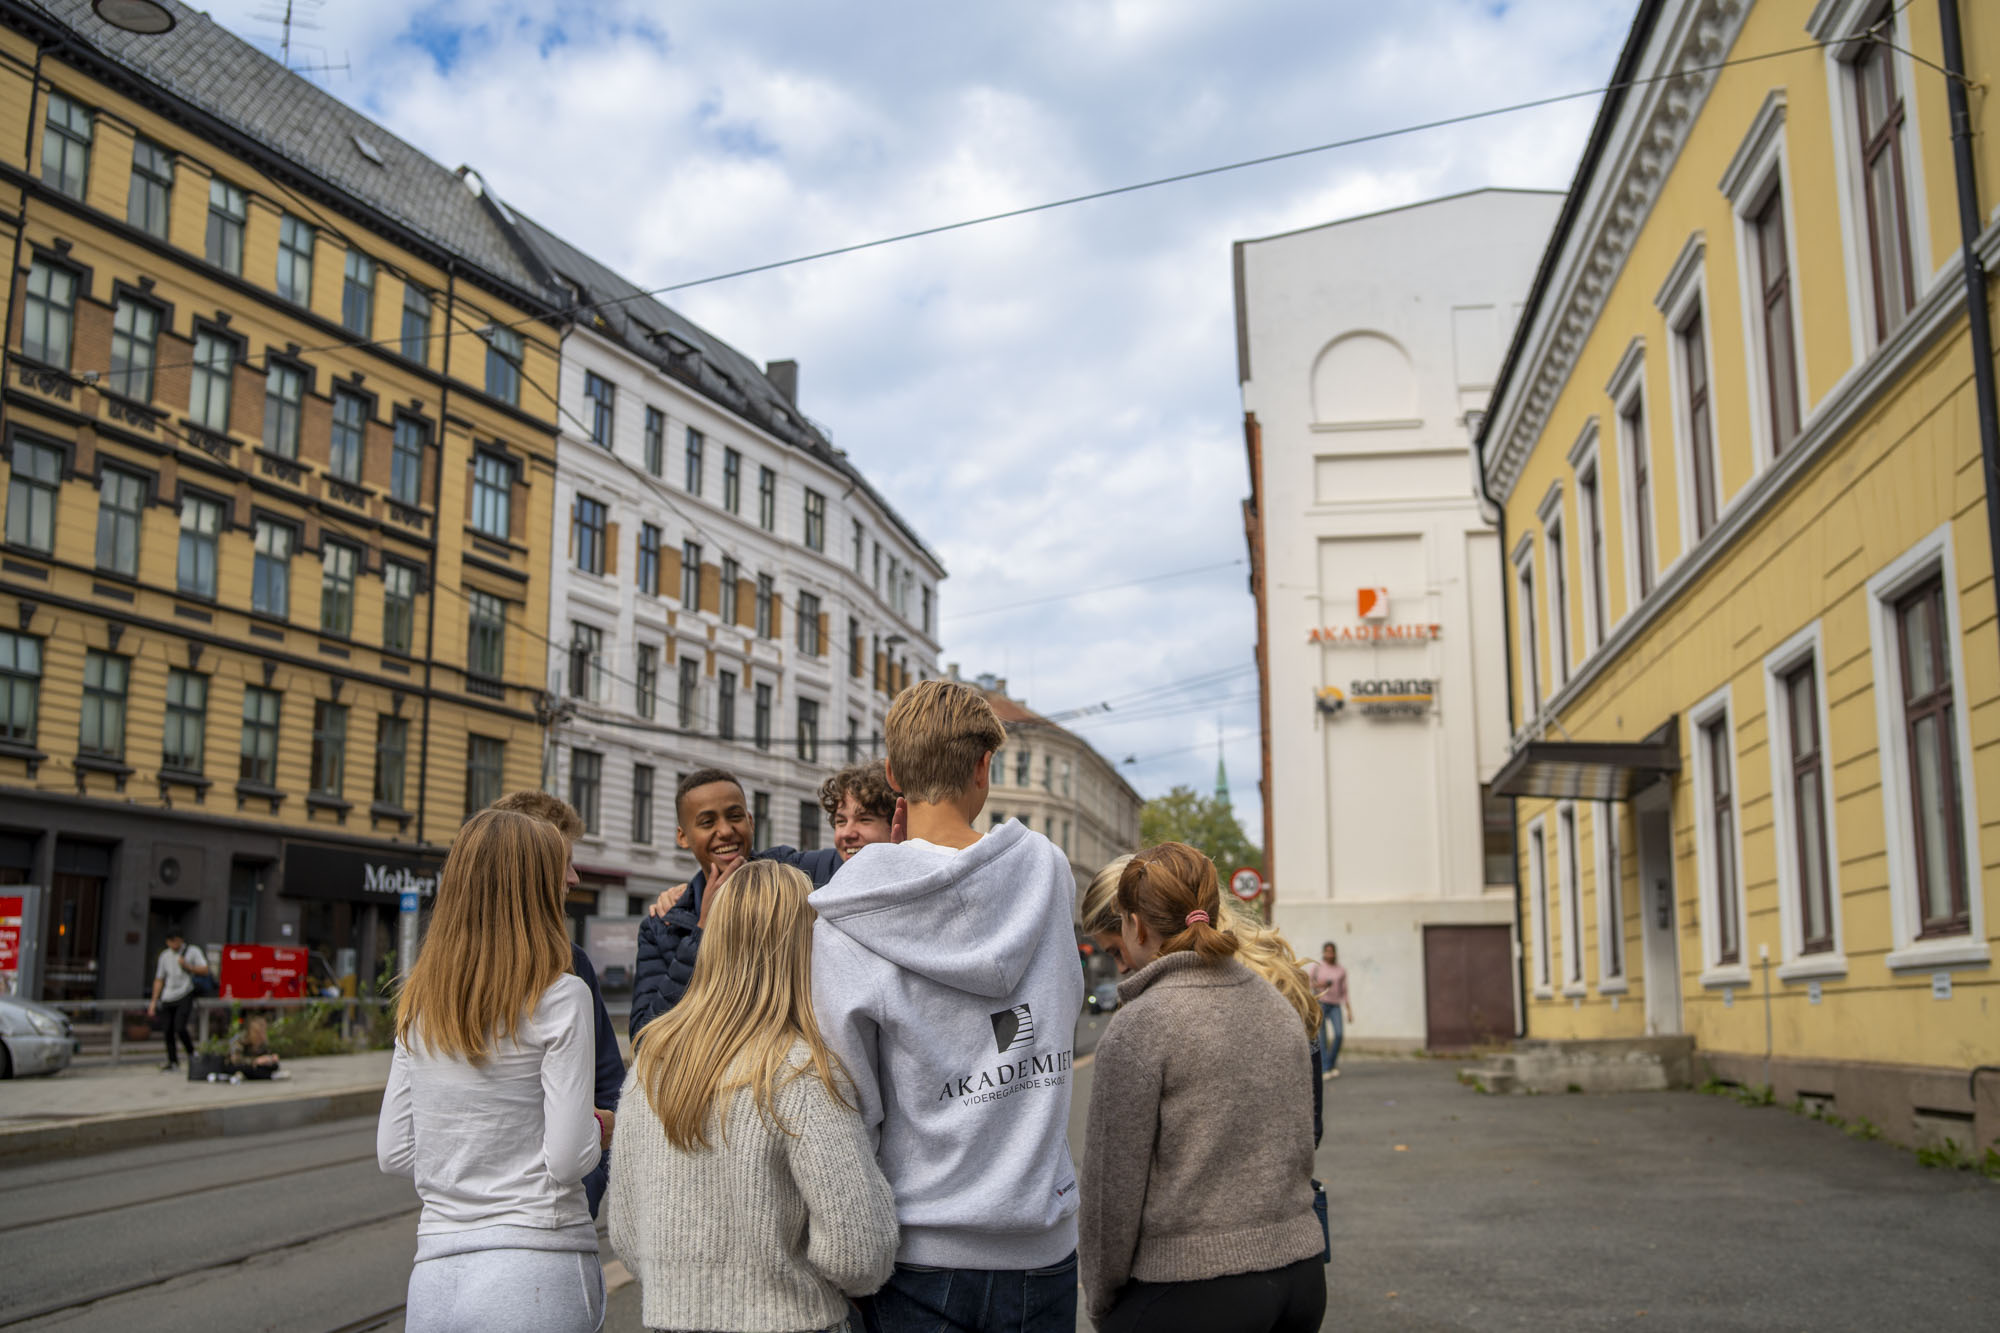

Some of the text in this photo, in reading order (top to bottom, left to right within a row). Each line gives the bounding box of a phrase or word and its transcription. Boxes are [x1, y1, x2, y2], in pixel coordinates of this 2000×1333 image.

[1308, 624, 1441, 644] AKADEMIET
[1350, 678, 1434, 696] sonans
[363, 863, 436, 896] Mother
[1236, 875, 1257, 891] 30
[938, 1050, 1072, 1101] AKADEMIET
[962, 1081, 1041, 1107] VIDEREGÅENDE
